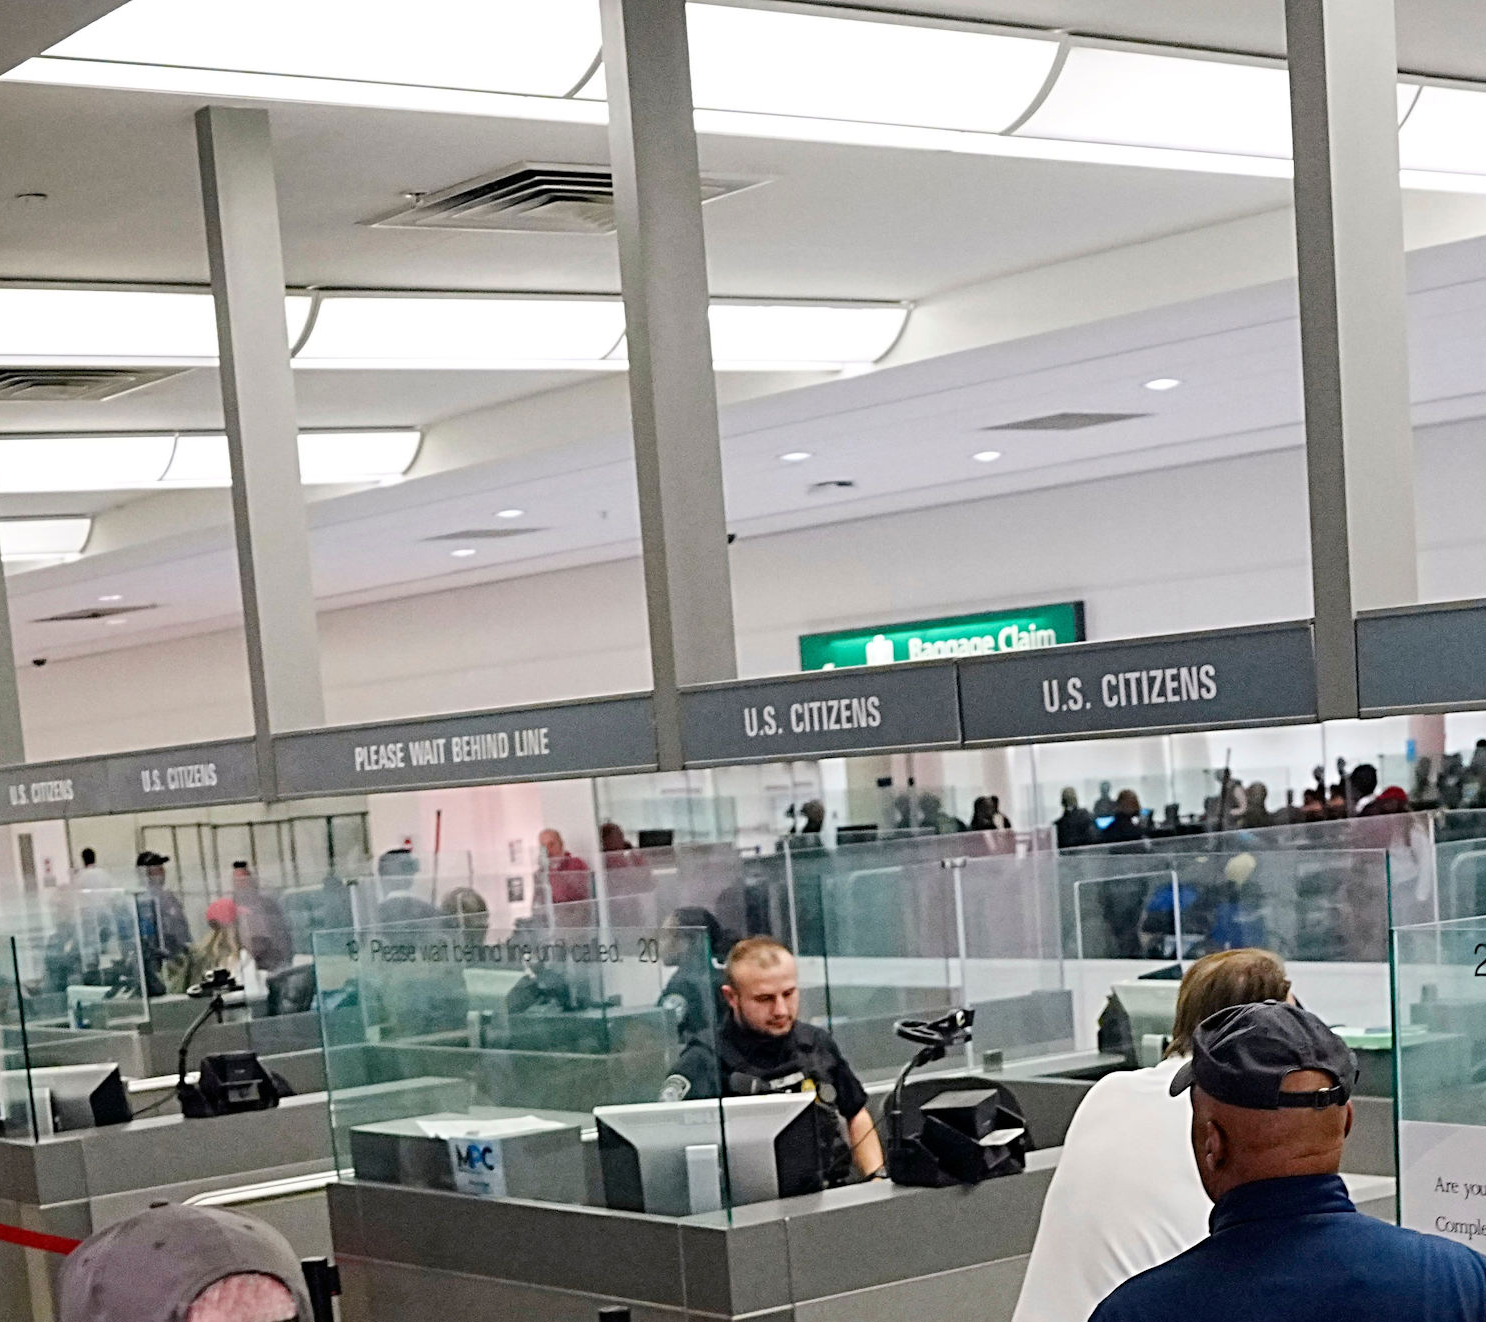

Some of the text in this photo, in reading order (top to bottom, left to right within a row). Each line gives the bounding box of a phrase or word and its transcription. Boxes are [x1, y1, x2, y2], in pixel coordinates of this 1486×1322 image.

[998, 623, 1058, 653] Claim
[1042, 664, 1218, 713] U.S. CITIZENS
[743, 695, 882, 738] U.S. CITIZENS
[354, 727, 551, 772] PLEASE WAIT BEHIND LINE
[140, 762, 218, 794] U.S. CITIZENS
[638, 936, 661, 965] 20
[455, 1144, 495, 1171] MPC
[1433, 1176, 1459, 1195] Are
